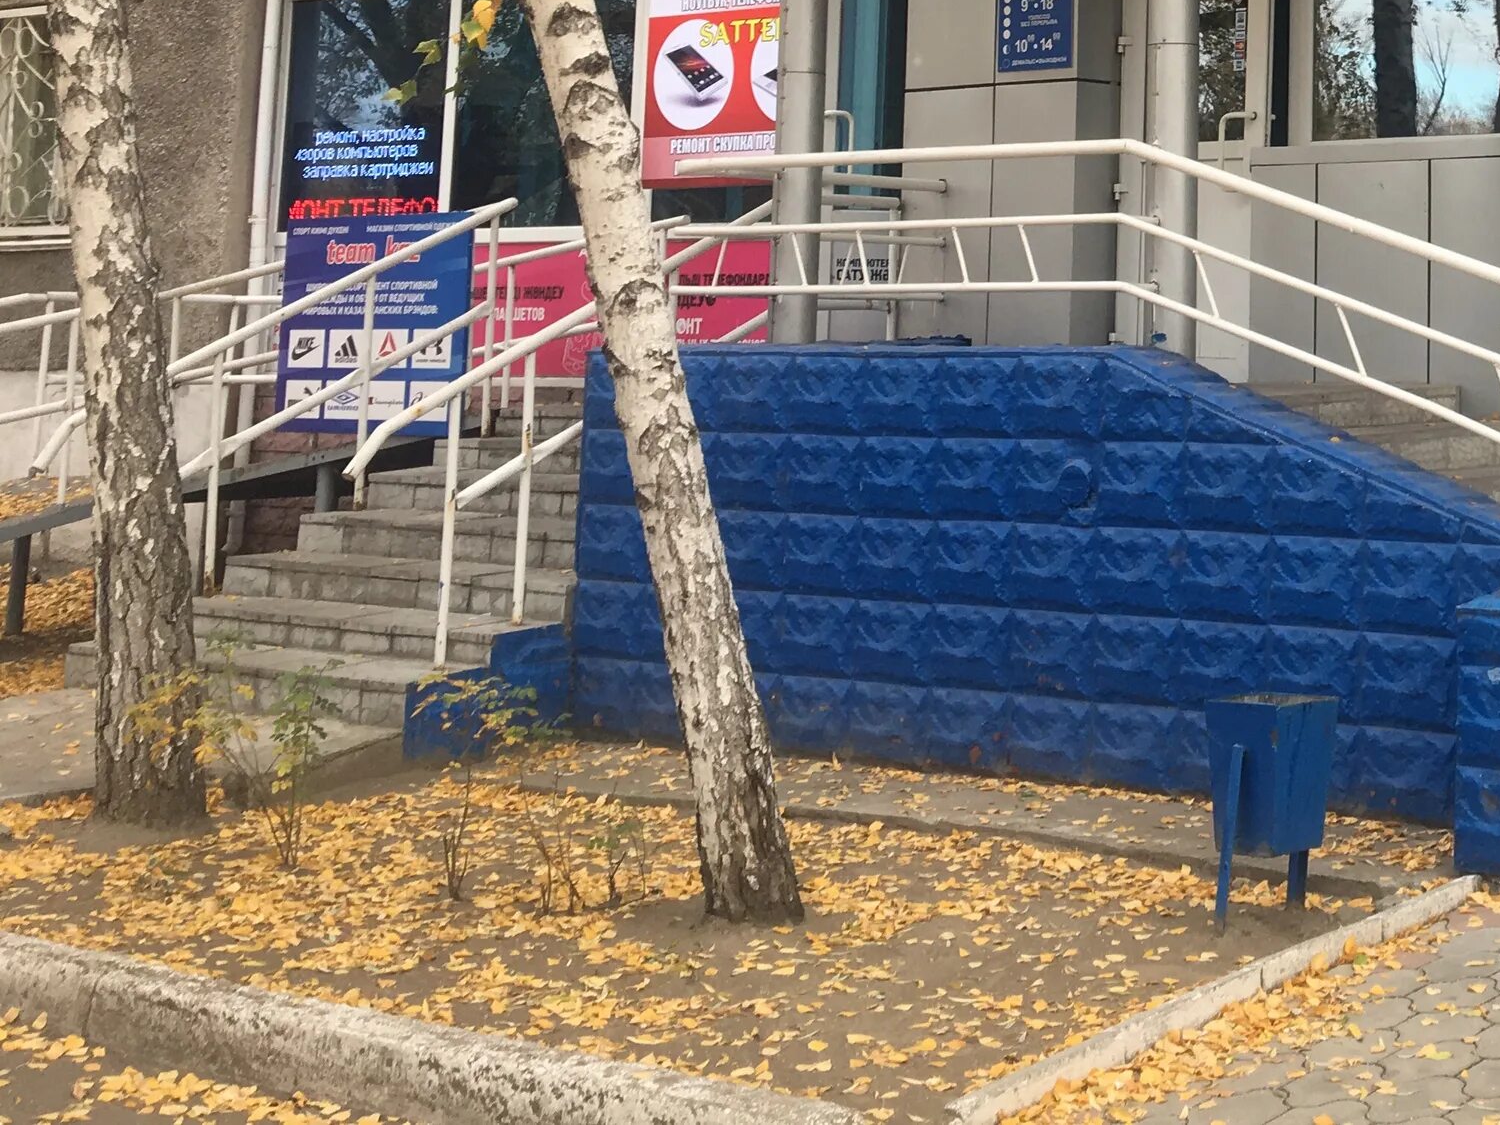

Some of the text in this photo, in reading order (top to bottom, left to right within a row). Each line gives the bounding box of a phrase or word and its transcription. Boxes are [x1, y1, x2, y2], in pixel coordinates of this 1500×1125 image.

[361, 125, 426, 143] настройка
[337, 144, 418, 161] компьютеров
[670, 136, 711, 155] РЕМОНТ
[713, 134, 754, 153] СКУПКА
[302, 164, 358, 181] заправка
[296, 336, 316, 349] NIKE
